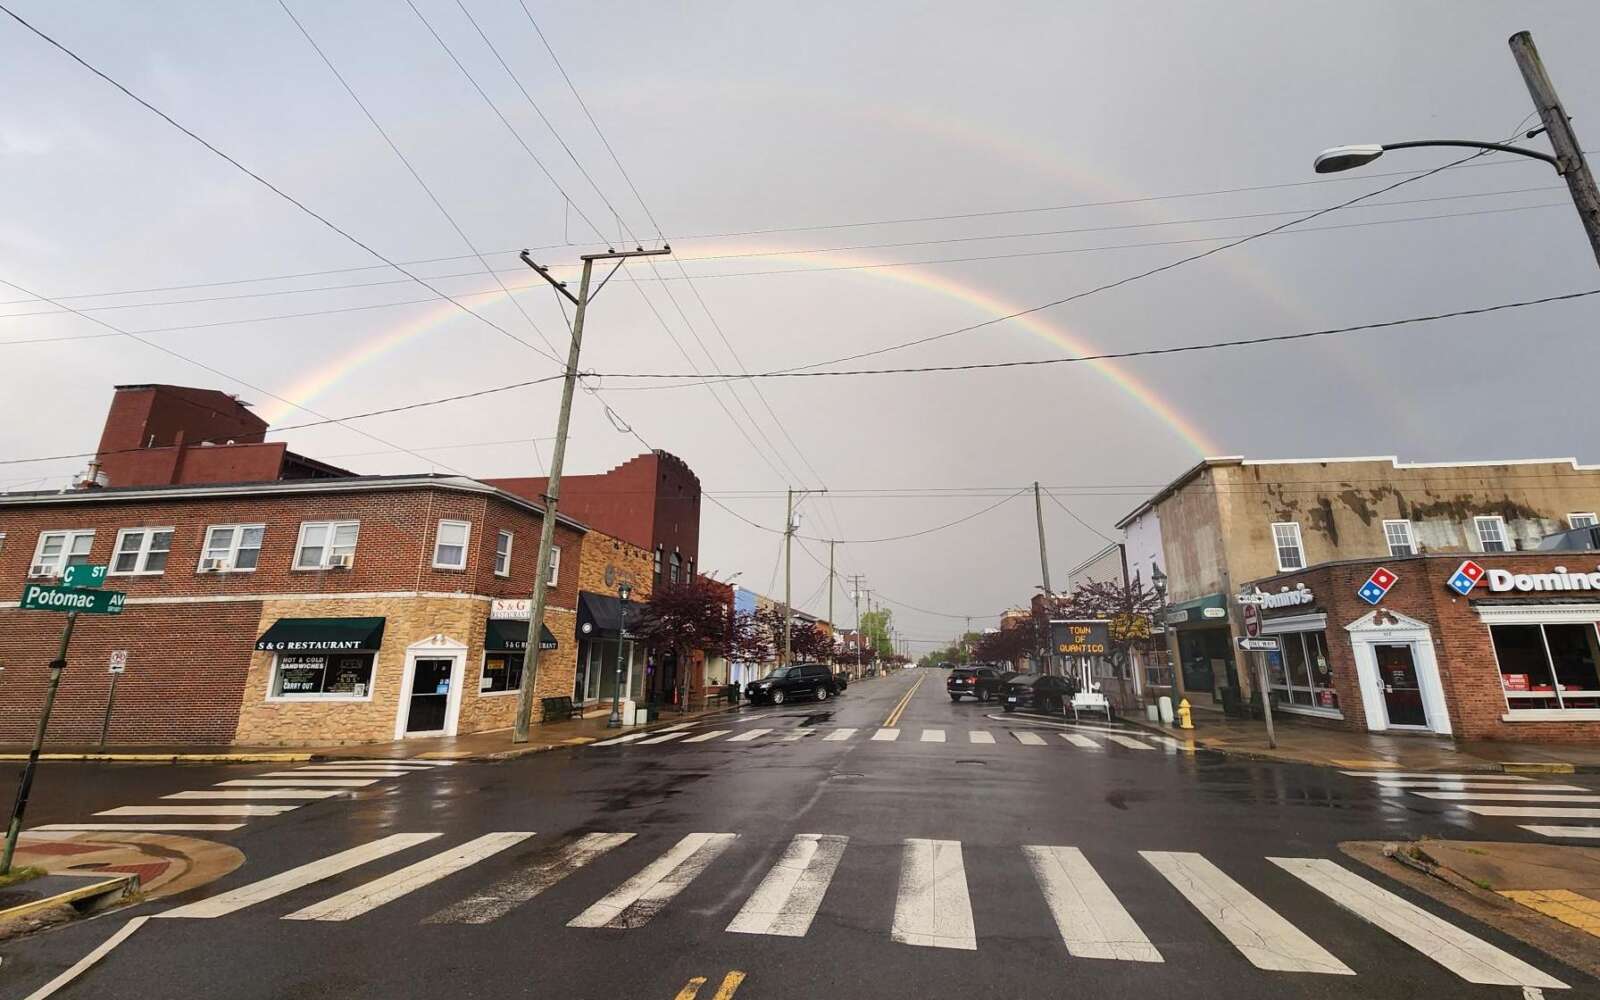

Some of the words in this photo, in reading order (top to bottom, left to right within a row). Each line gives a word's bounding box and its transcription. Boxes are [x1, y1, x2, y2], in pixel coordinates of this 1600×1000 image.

[64, 566, 75, 582] C
[91, 566, 107, 577] ST
[26, 586, 95, 608] Potomac
[497, 600, 504, 610] S
[516, 600, 525, 610] G
[1069, 626, 1091, 634] TOWN
[1075, 635, 1086, 643] OF
[258, 641, 265, 650] S
[266, 641, 274, 650] &
[276, 641, 285, 650] G
[287, 641, 361, 650] RESTAURANT
[1059, 644, 1104, 653] QUANTICO
[283, 682, 301, 690] CARRY
[301, 682, 314, 690] OUT
